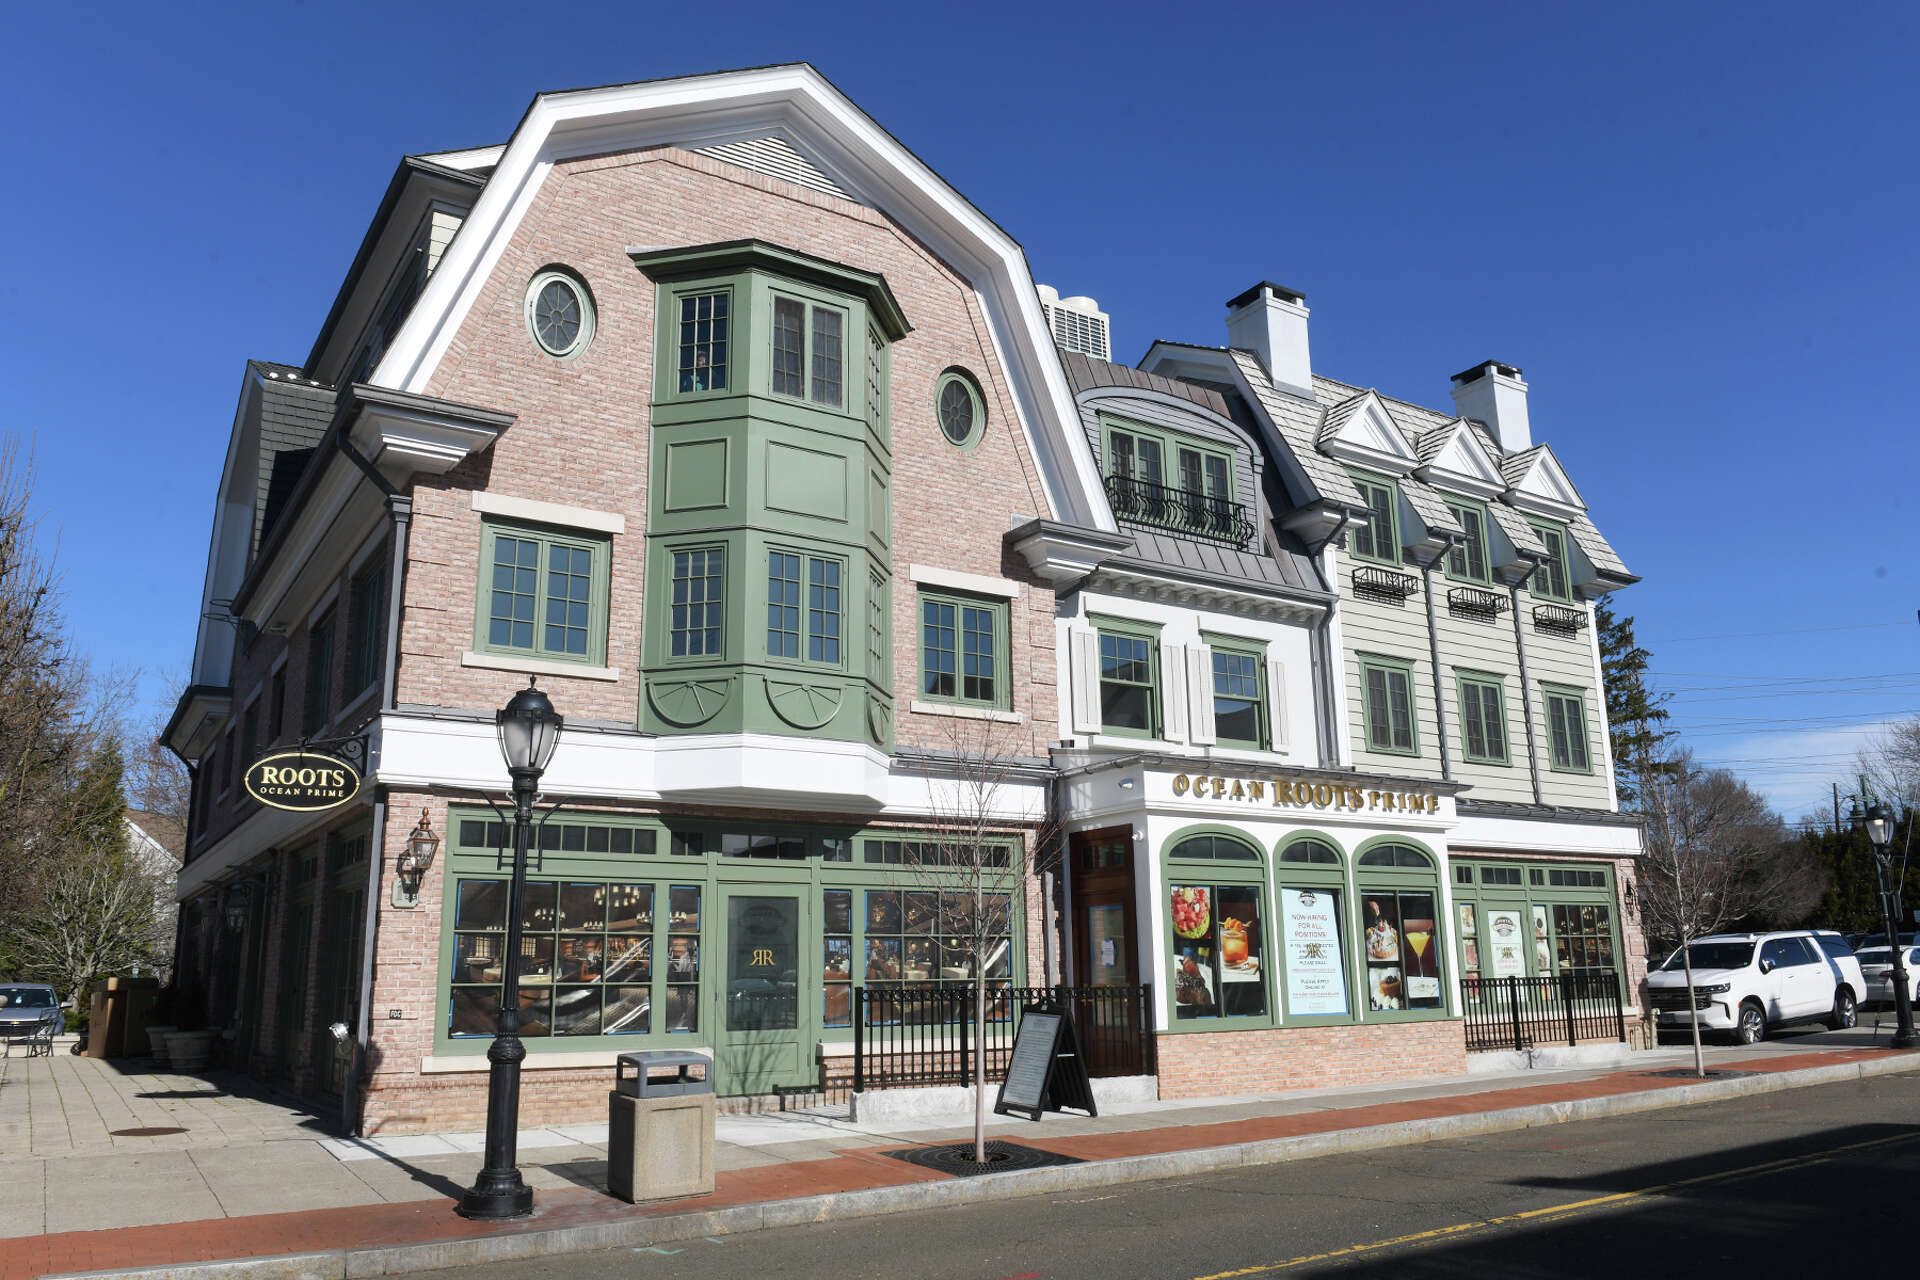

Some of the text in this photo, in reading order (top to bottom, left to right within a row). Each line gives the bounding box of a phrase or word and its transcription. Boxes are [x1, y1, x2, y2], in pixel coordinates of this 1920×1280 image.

[261, 766, 345, 787] ROOTS
[260, 787, 344, 797] OCEAN PRIME
[1173, 774, 1440, 811] OCEAN ROOTS PRIME
[390, 1010, 401, 1018] FDC
